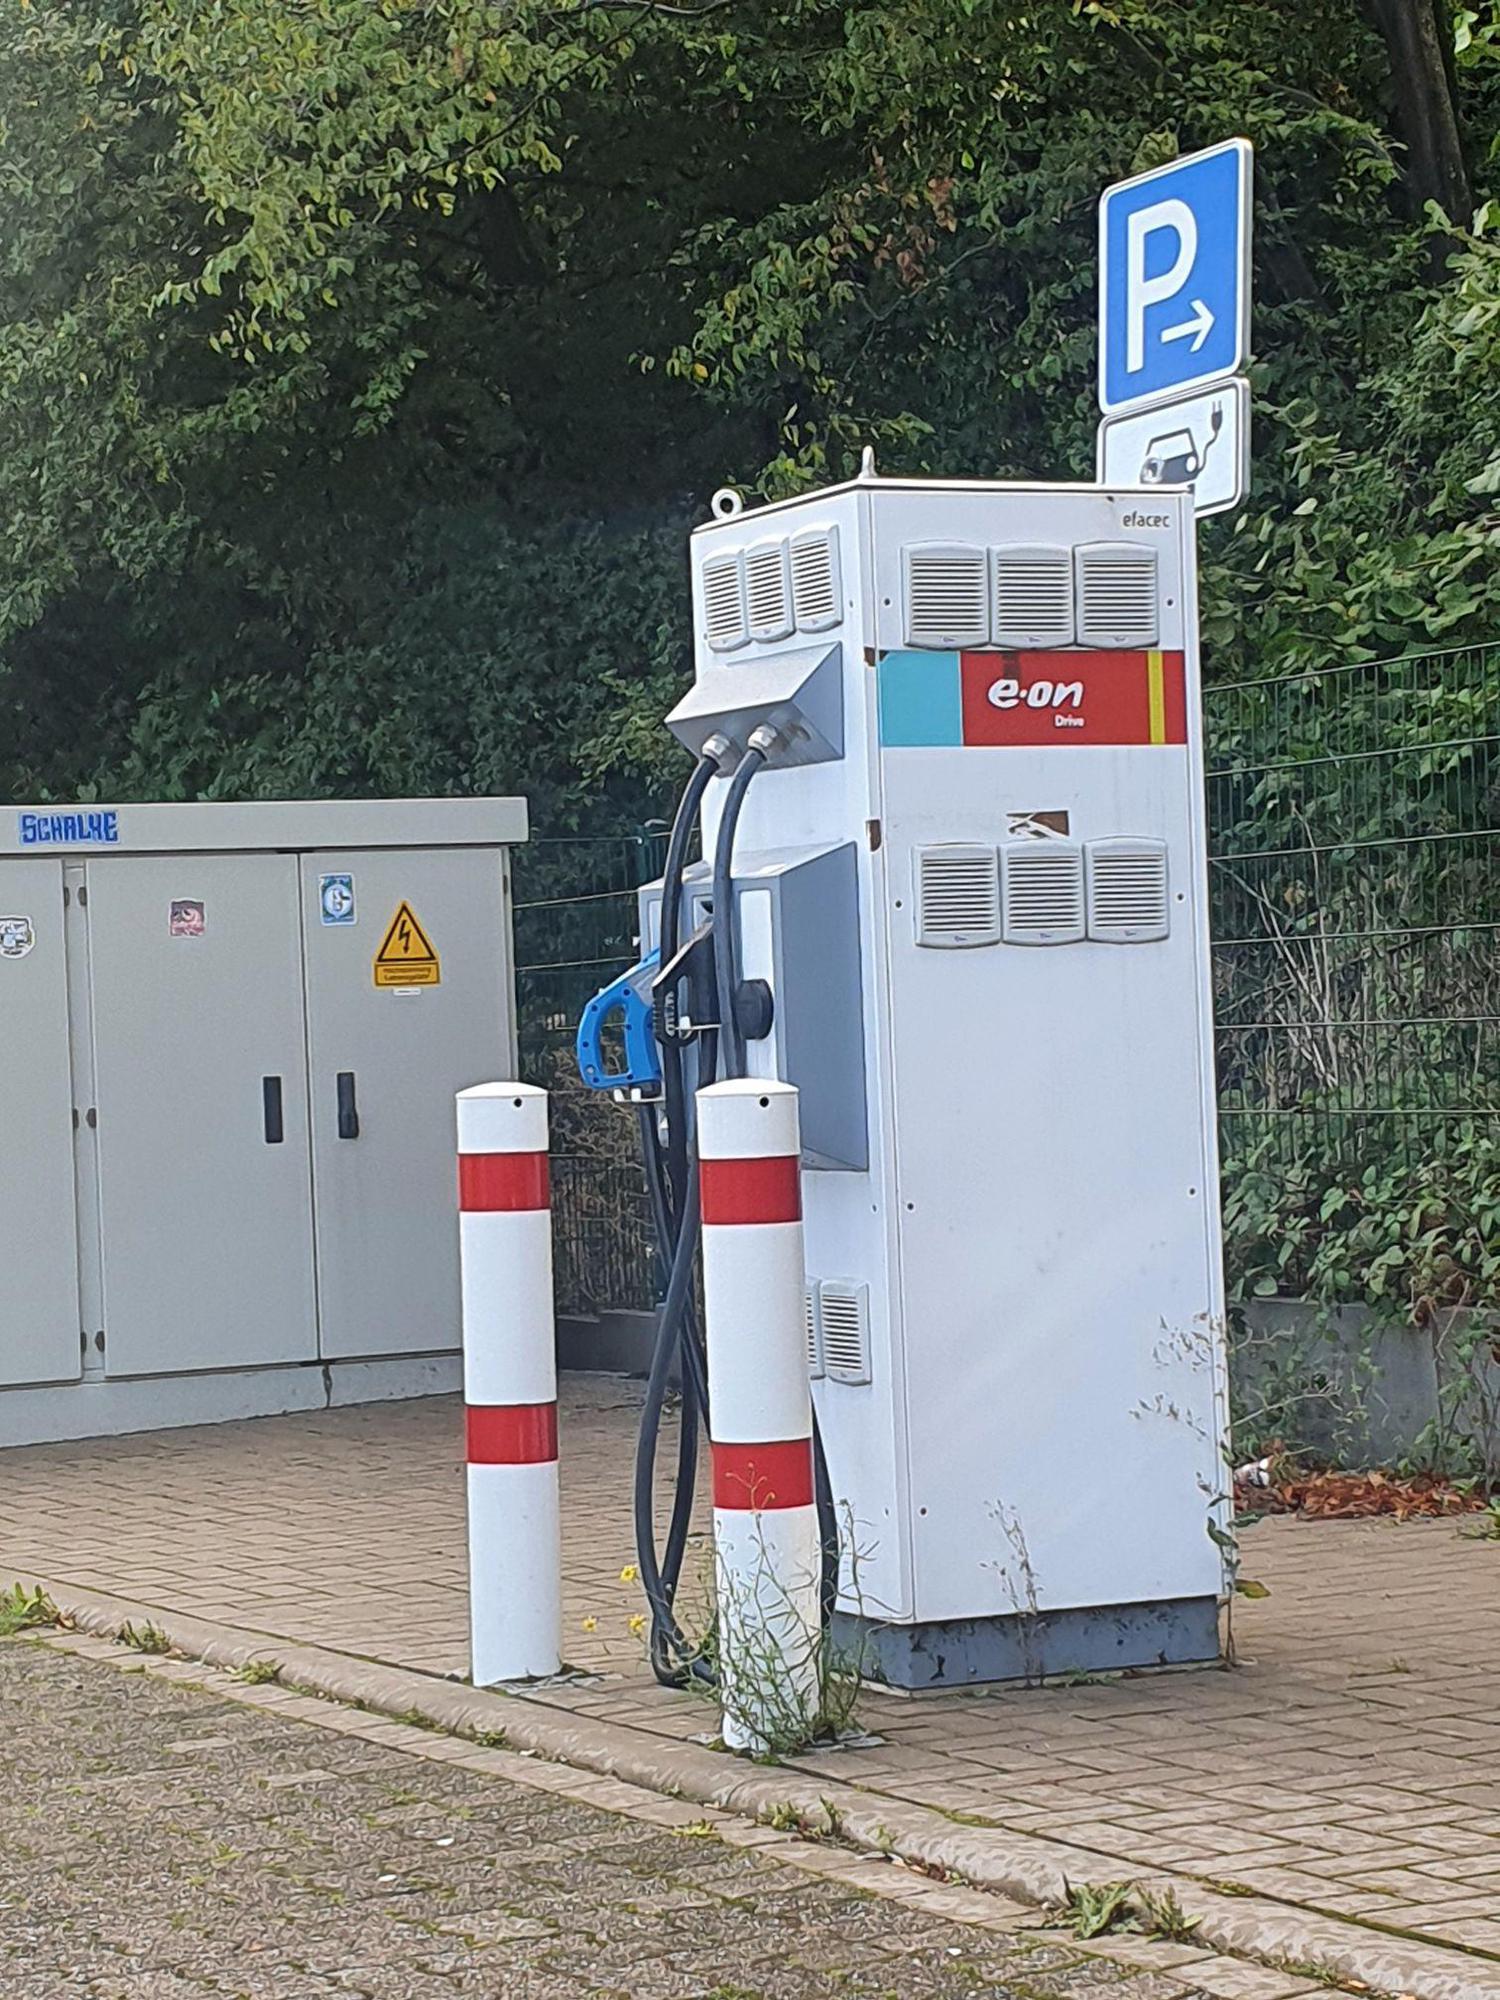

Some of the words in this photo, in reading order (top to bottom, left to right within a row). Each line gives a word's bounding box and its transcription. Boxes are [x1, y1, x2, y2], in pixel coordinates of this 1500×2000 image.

[1127, 198, 1198, 373] P
[1122, 510, 1171, 528] efacec
[1054, 714, 1085, 727] Drive
